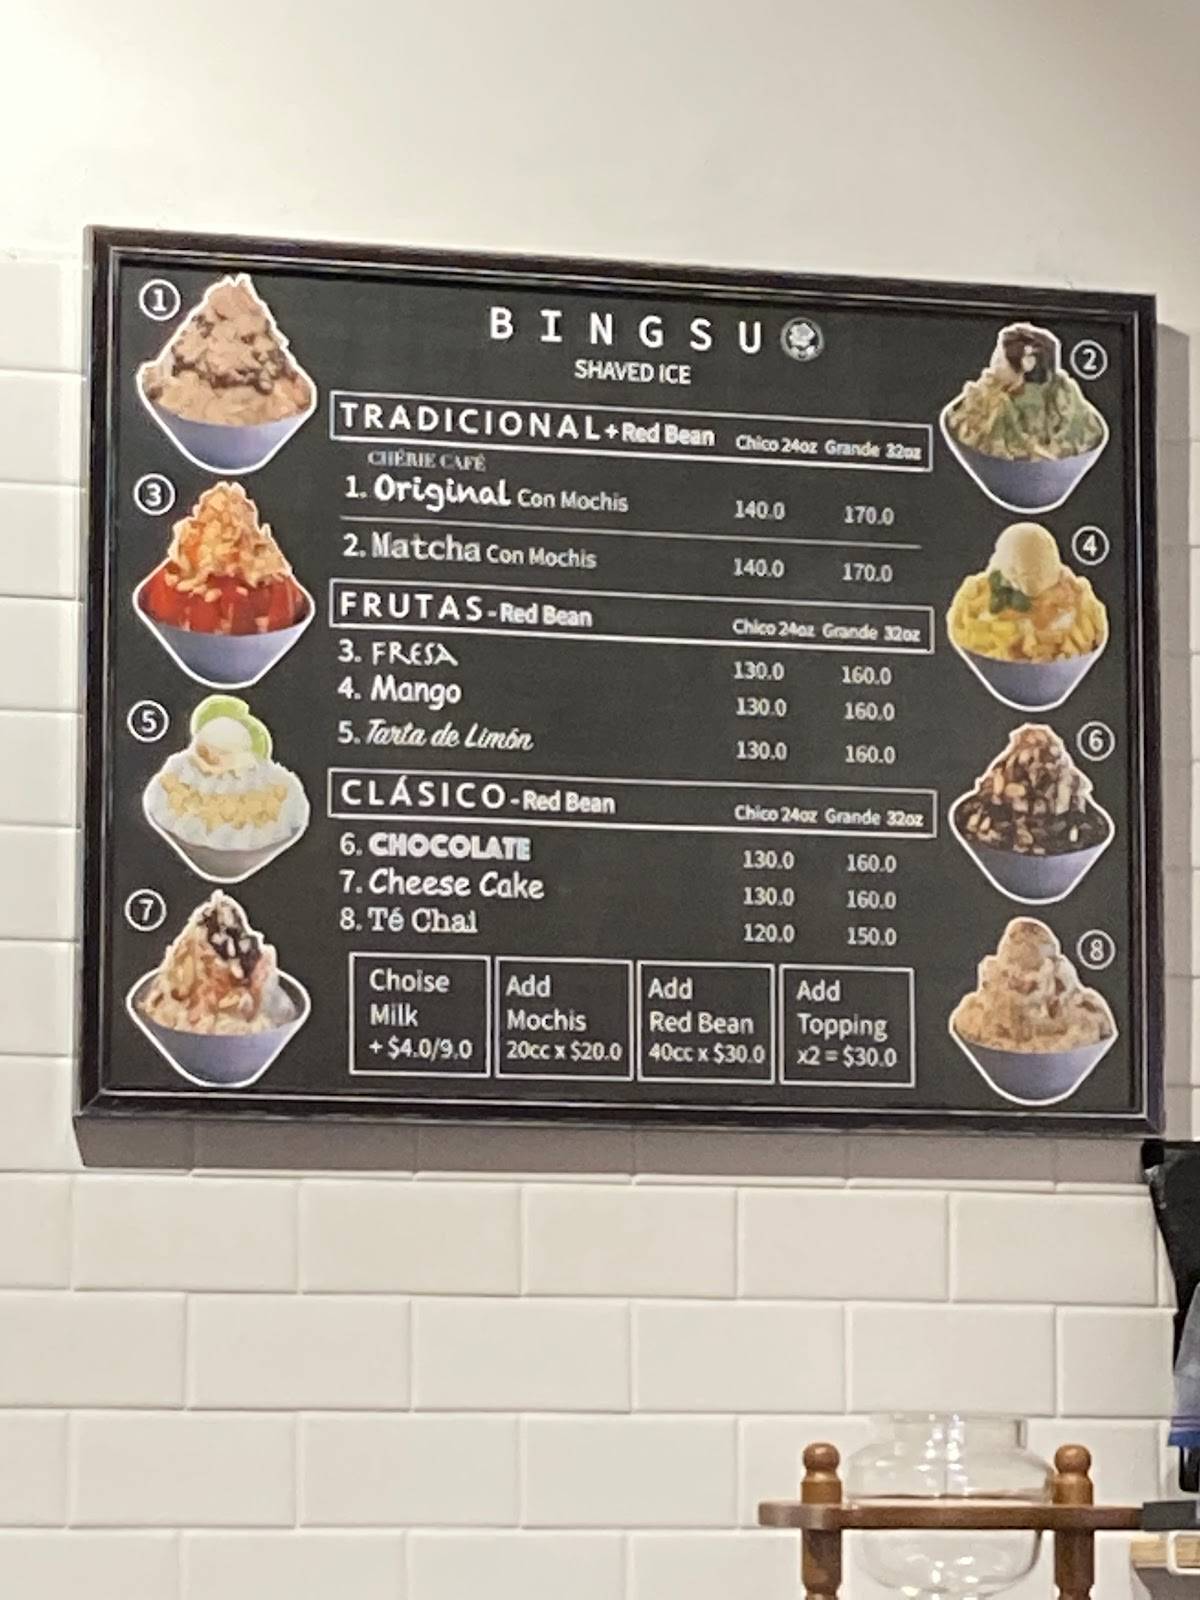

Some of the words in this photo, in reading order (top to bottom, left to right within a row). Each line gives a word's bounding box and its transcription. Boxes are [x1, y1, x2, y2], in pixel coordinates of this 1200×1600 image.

[489, 305, 763, 354] BINGSU
[573, 358, 655, 384] SHAVED
[659, 364, 692, 385] ICE
[664, 424, 716, 447] Bean
[735, 434, 780, 452] Chico
[824, 439, 881, 458] Grande
[345, 475, 367, 499] 1.
[373, 473, 512, 513] Original
[517, 488, 556, 508] Con
[560, 490, 630, 513] Mochis
[734, 500, 787, 521] 140.0
[843, 506, 896, 526] 170.0
[342, 532, 366, 559] 2.
[371, 531, 482, 563] Matcha
[485, 544, 524, 565] Con
[528, 547, 598, 569] Mochis
[733, 558, 786, 578] 140.0
[842, 563, 894, 583] 170.0
[542, 604, 594, 628] Bean
[732, 618, 777, 637] Chico
[778, 621, 816, 638] 24oz
[822, 623, 879, 641] Grande
[337, 638, 362, 664] 3.
[371, 641, 459, 667] FRESA
[733, 661, 785, 681] 130.0
[841, 666, 893, 686] 160.0
[337, 676, 361, 701] 4.
[370, 674, 463, 711] Mango
[735, 697, 788, 718] 130.0
[844, 702, 897, 722] 160.0
[337, 719, 362, 745] 5.
[366, 718, 428, 748] Tarta
[429, 722, 461, 749] de
[464, 723, 536, 752] Limón
[736, 740, 788, 761] 130.0
[844, 745, 897, 765] 160.0
[564, 791, 617, 815] Bean
[733, 804, 779, 823] Chico
[780, 807, 819, 824] 24oz
[824, 807, 881, 826] Grande
[885, 810, 924, 828] 32oz
[339, 832, 363, 857] 6.
[367, 832, 533, 862] CHOCOLATE
[742, 850, 796, 870] 130.0
[845, 853, 898, 874] 160.0
[338, 869, 363, 895] 7.
[368, 867, 472, 897] Cheese
[478, 870, 546, 900] Cake
[742, 886, 796, 907] 130.0
[845, 890, 898, 910] 160.0
[339, 907, 363, 932] 8.
[367, 906, 405, 932] Té
[410, 908, 479, 934] Chai
[743, 923, 796, 943] 120.0
[846, 926, 898, 946] 150.0
[368, 968, 451, 993] Choise
[505, 974, 552, 998] Add
[648, 976, 694, 1001] Add
[796, 979, 842, 1003] Add
[369, 1003, 419, 1028] Milk
[506, 1008, 588, 1032] Mochis
[648, 1010, 692, 1034] Red
[697, 1012, 755, 1035] Bean
[797, 1012, 888, 1041] Topping
[386, 1035, 474, 1062] $4.0/9.0
[506, 1040, 550, 1060] 20cc
[569, 1040, 624, 1062] $20.0
[648, 1043, 693, 1063] 40cc
[711, 1043, 766, 1065] $30.0
[796, 1045, 821, 1066] x2
[841, 1046, 898, 1068] $30.0
